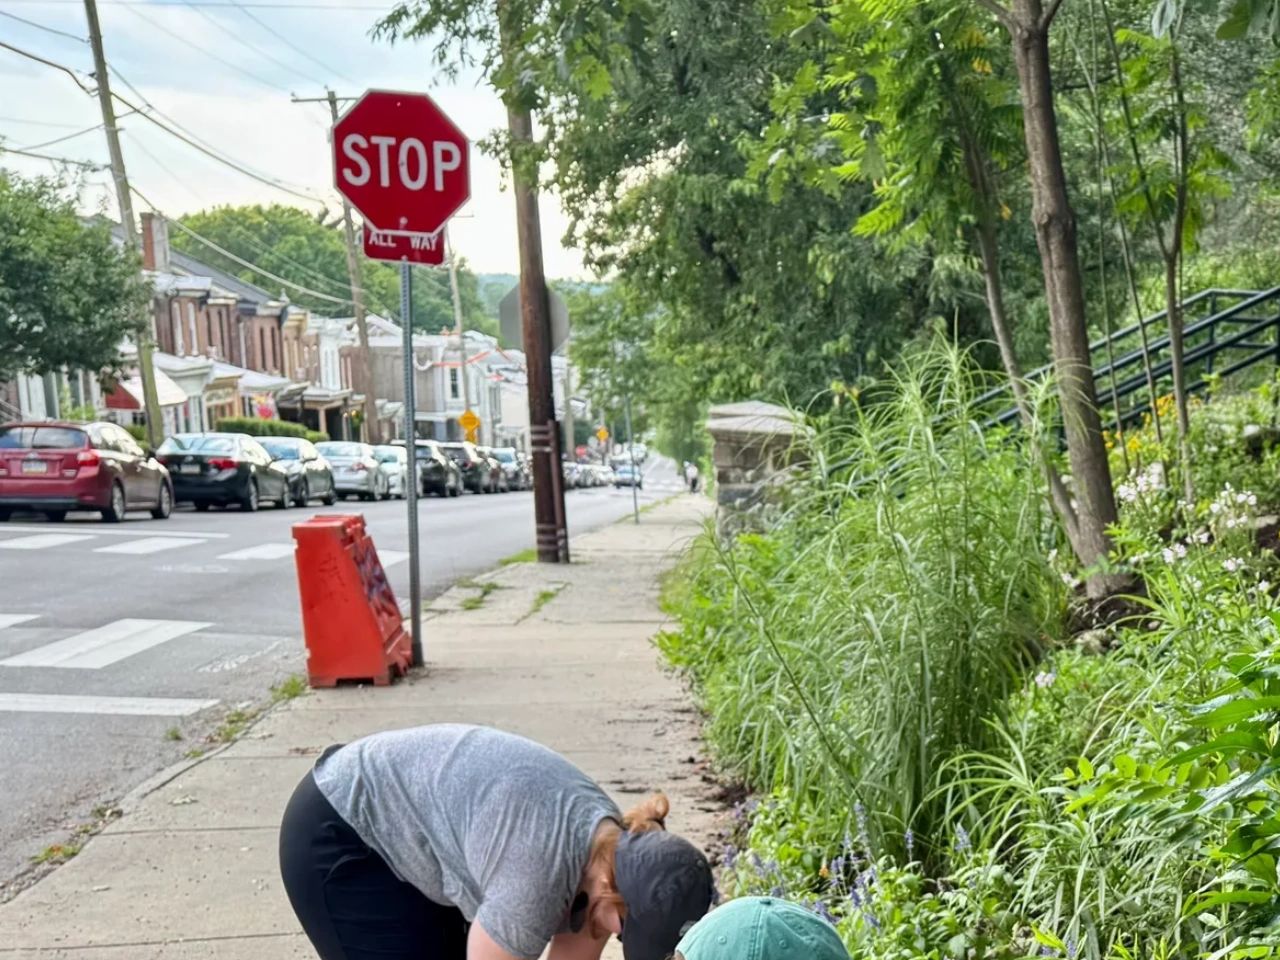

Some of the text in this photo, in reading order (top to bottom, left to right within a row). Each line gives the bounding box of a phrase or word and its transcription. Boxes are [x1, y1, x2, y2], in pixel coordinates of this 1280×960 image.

[342, 133, 462, 192] STOP
[368, 232, 438, 251] ALL WAY
